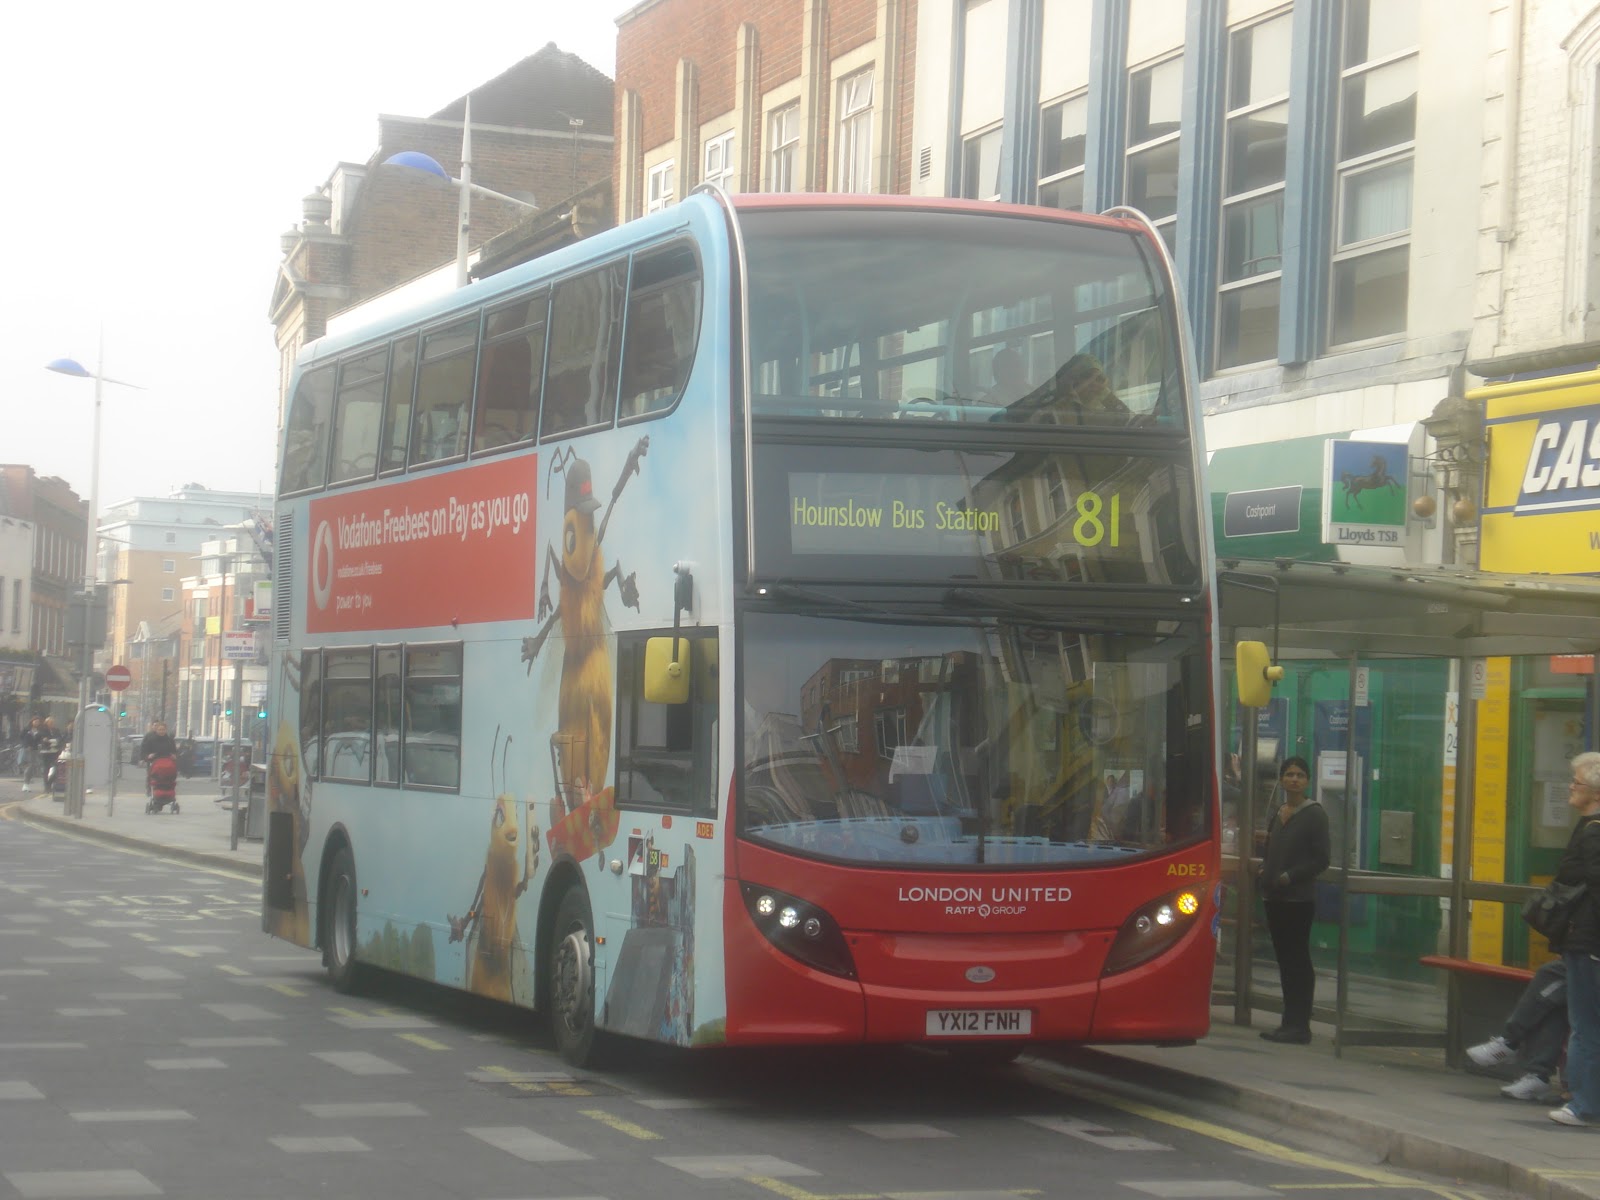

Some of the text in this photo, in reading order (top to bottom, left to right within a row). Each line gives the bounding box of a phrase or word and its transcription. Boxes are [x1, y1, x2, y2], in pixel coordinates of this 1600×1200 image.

[793, 497, 999, 532] Hounslow Bus Station
[1073, 491, 1120, 548] 81
[1246, 503, 1276, 520] Cashpoint
[338, 493, 529, 549] Vodafone Freebees on Pay as you go
[1338, 527, 1398, 544] Lloyds TSB
[899, 887, 1072, 902] LONDON UNITED
[945, 906, 1027, 915] RATP GROUP
[938, 1011, 1020, 1031] YX12 FNH
